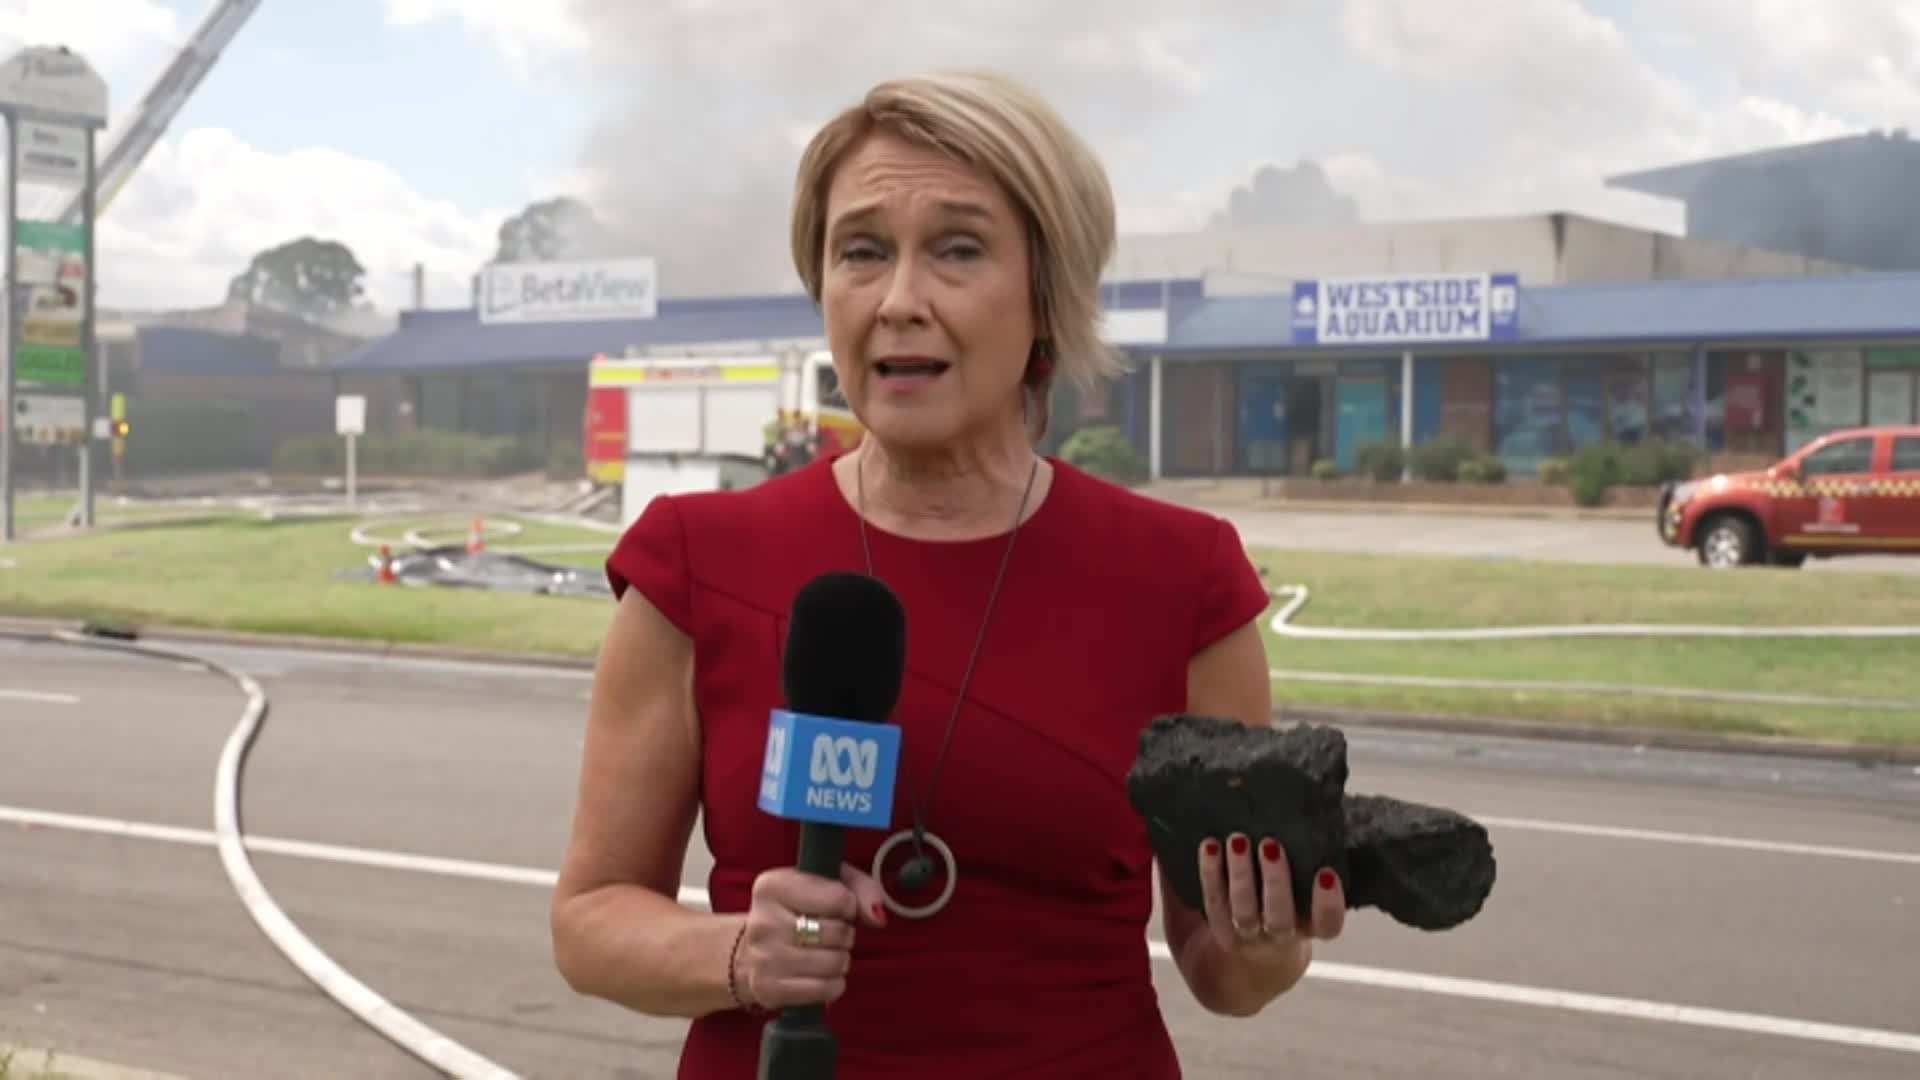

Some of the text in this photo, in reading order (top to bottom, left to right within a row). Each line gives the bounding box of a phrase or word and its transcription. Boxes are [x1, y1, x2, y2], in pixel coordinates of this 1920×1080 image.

[521, 272, 647, 304] BetaView
[1326, 279, 1481, 308] WESTSIDE
[1326, 308, 1481, 337] AQUARIUM
[806, 787, 871, 812] NEWS
